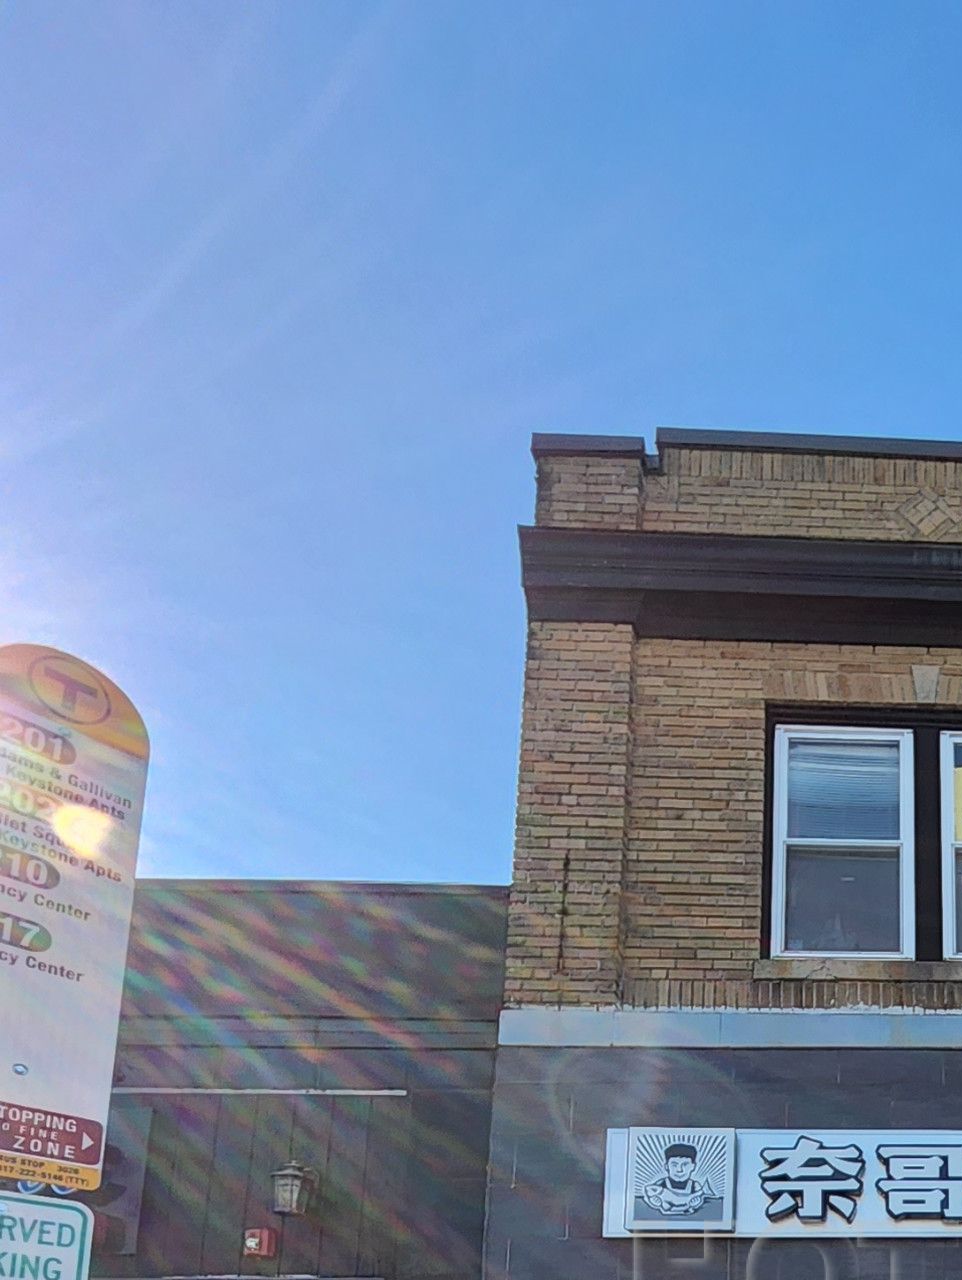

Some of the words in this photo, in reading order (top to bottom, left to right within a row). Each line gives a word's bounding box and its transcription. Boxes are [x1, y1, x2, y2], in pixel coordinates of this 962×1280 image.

[43, 666, 98, 713] T
[33, 893, 91, 921] Center
[25, 955, 85, 982] Center
[20, 1125, 58, 1140] FINE
[13, 1135, 76, 1158] ZONE
[21, 1158, 45, 1168] STOP
